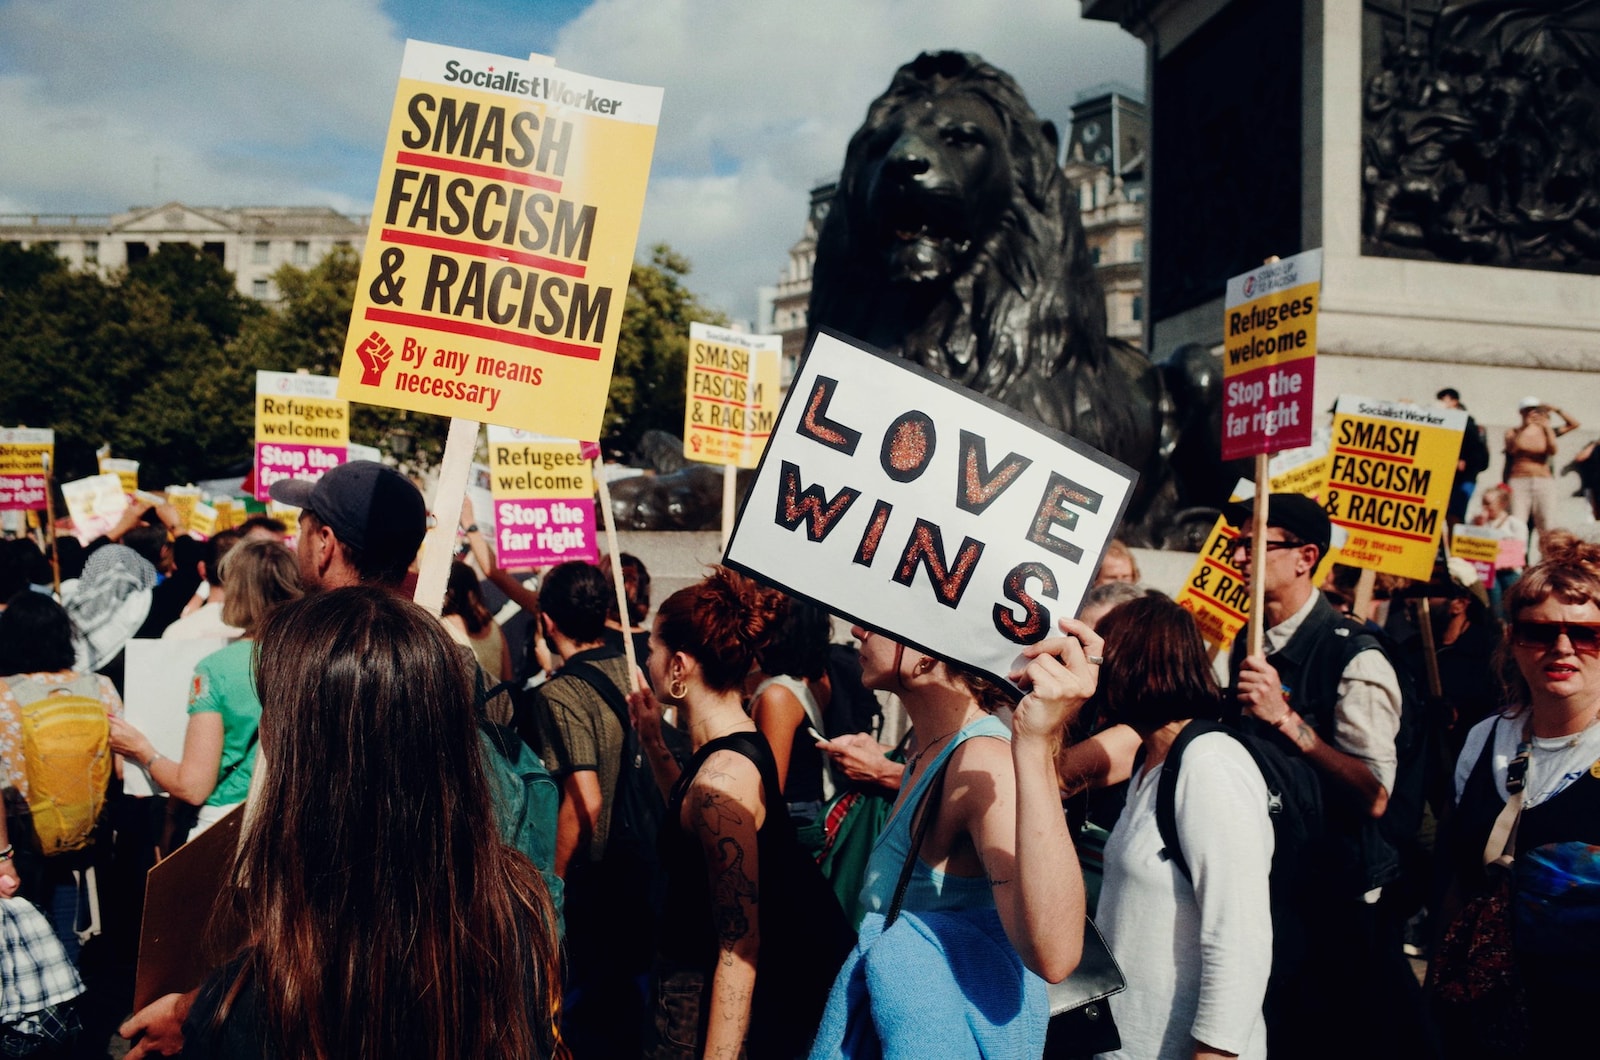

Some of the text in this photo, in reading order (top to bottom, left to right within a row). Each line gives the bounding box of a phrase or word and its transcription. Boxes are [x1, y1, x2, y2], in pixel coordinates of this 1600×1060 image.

[443, 60, 622, 115] Socialist Worker
[402, 92, 574, 176] SMASH
[385, 168, 598, 262] FASCISM
[369, 246, 613, 344] & RACISM
[1230, 296, 1313, 336] Refugees
[401, 337, 543, 386] By any means
[695, 343, 750, 373] SMASH
[1230, 329, 1307, 365] welcome
[395, 372, 501, 412] necessary
[693, 372, 762, 402] FASCISM
[1227, 370, 1302, 407] Stop the
[263, 398, 344, 420] Refugees
[691, 401, 772, 431] & RACISM
[1227, 400, 1299, 438] far right
[1358, 403, 1403, 420] Socialist
[263, 421, 340, 439] welcome
[1338, 419, 1420, 456] SMASH
[260, 445, 339, 470] Stop the
[496, 447, 585, 471] Refugees
[796, 375, 1104, 564] LOVE
[1330, 455, 1431, 496] FASCISM
[498, 471, 584, 490] welcome
[498, 502, 585, 529] Stop the
[1324, 490, 1438, 535] & RACISM
[500, 526, 585, 554] far right
[775, 460, 1059, 646] WINS
[1192, 566, 1250, 613] & RAC
